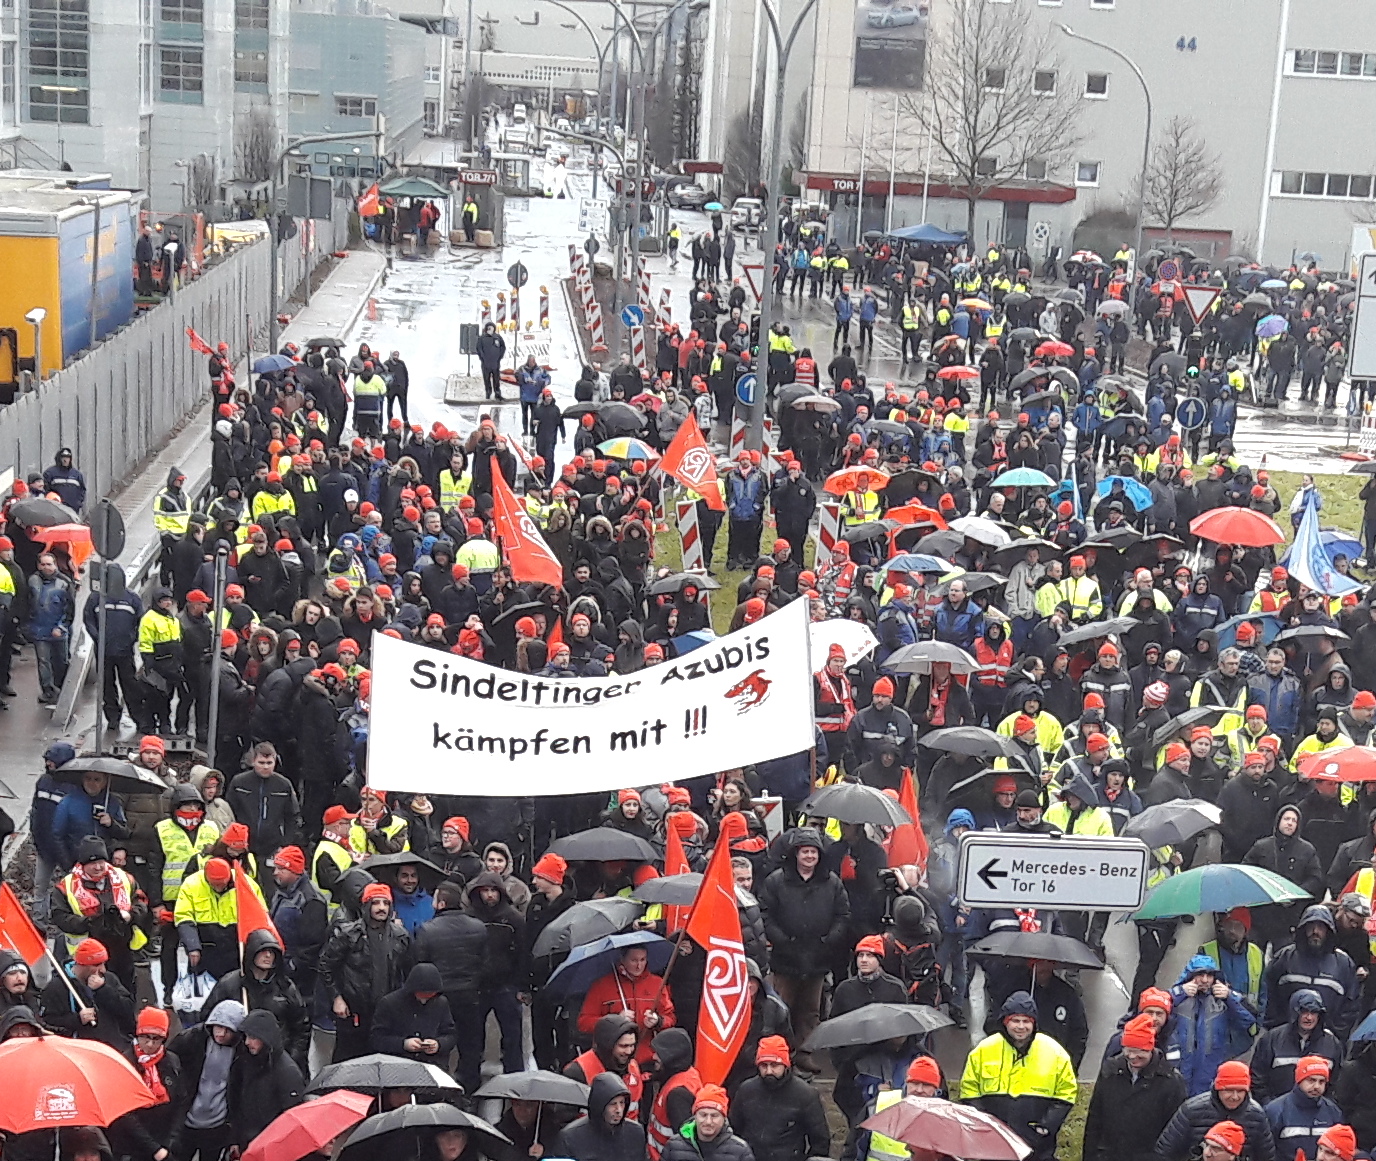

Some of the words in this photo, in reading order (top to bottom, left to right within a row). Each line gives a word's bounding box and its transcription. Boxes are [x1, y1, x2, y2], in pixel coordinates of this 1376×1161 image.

[1176, 35, 1197, 51] 44
[461, 172, 481, 181] TOR
[833, 180, 854, 190] TOR
[660, 635, 770, 686] Azubis
[433, 722, 591, 761] kämpfen
[610, 719, 666, 751] mit
[684, 705, 707, 738] !!!
[1011, 860, 1086, 876] Mercedes
[1099, 863, 1137, 878] Benz
[1011, 878, 1035, 893] Tor
[1042, 880, 1056, 893] 16
